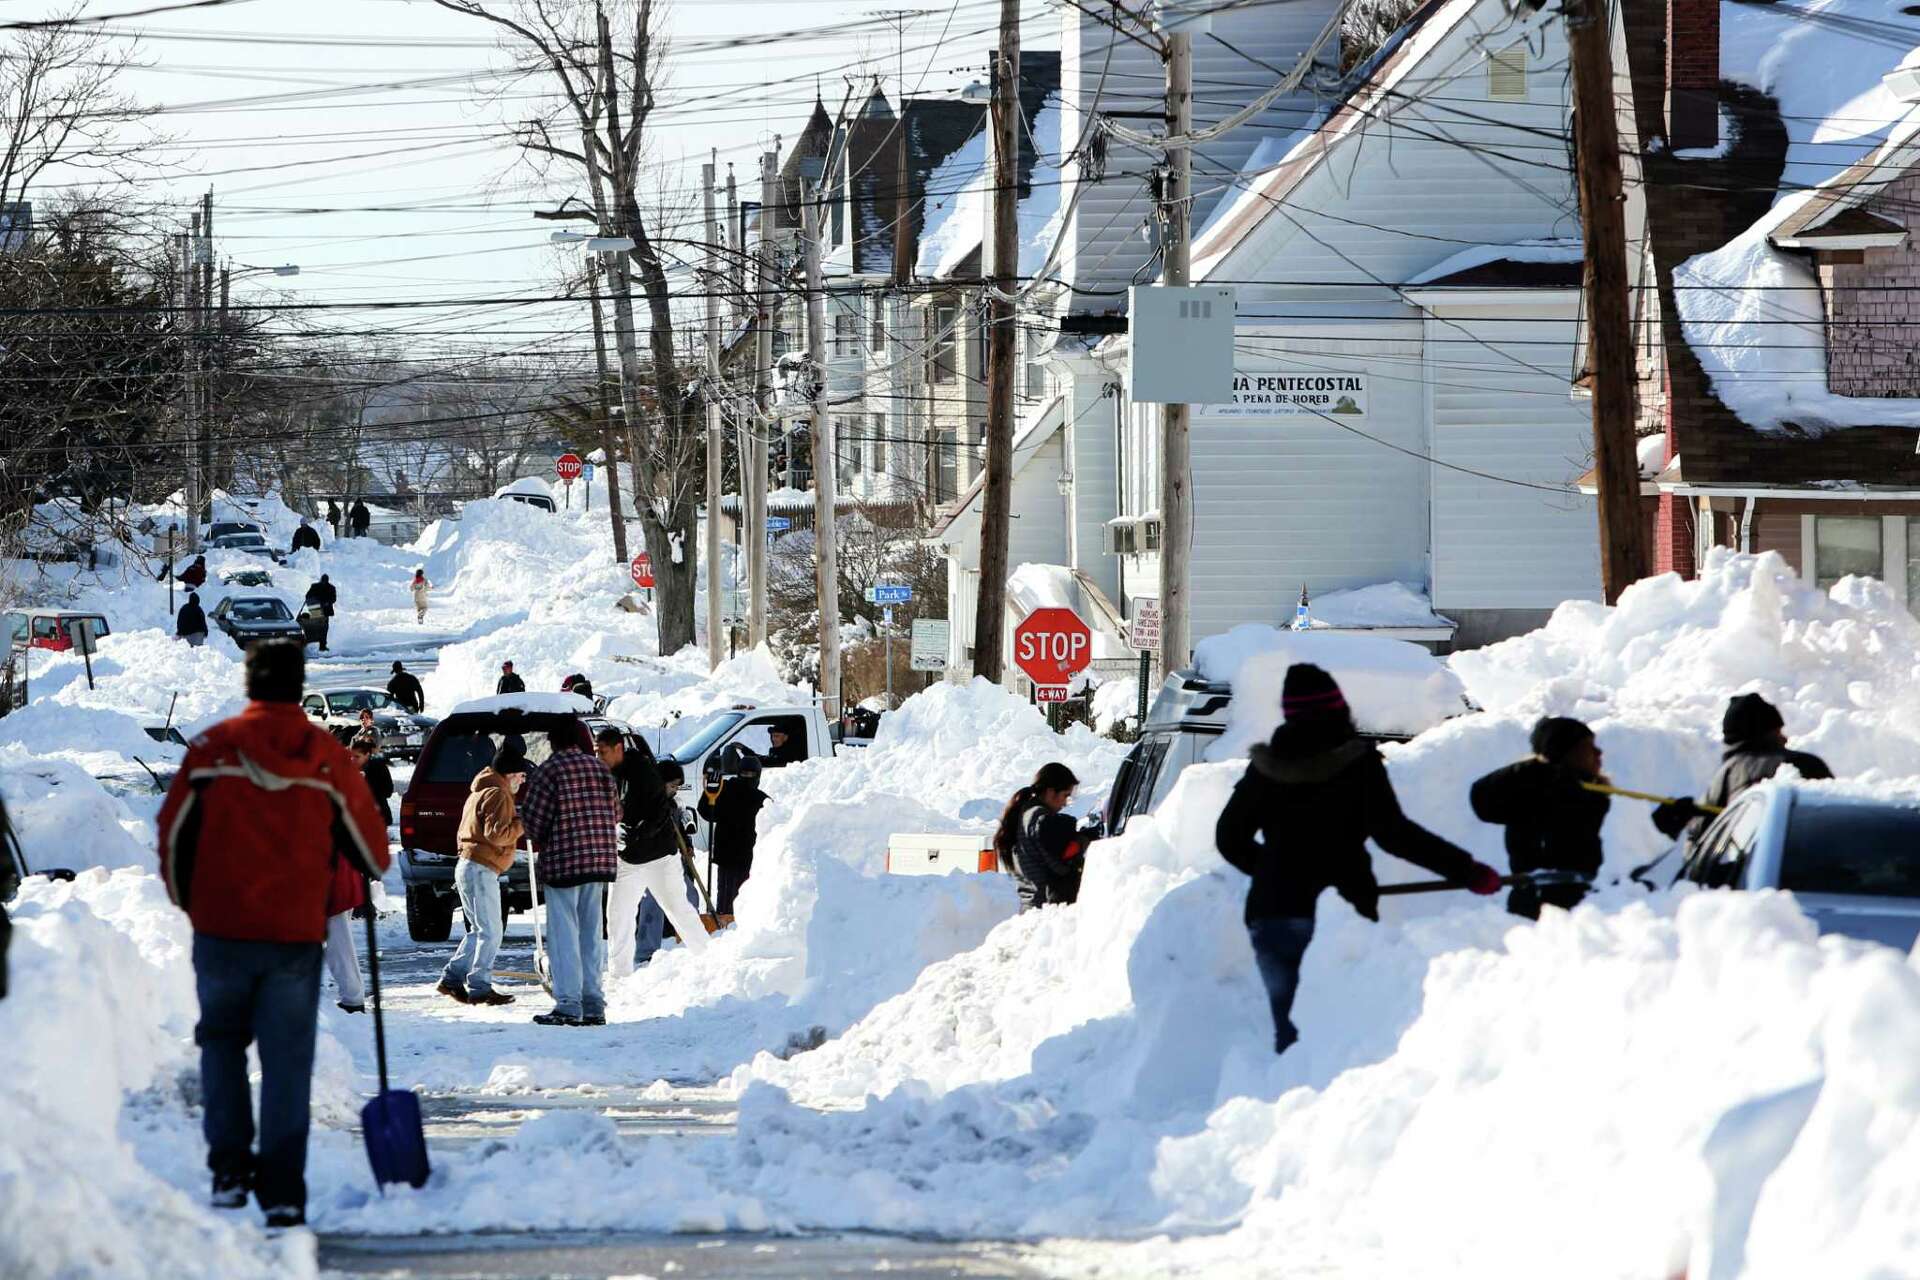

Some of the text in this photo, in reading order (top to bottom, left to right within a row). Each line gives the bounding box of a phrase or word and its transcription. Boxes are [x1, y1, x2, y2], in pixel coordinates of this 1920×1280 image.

[1257, 377, 1363, 390] PENTECOSTAL
[1275, 394, 1289, 404] DE
[1292, 394, 1330, 405] HOREB
[557, 462, 580, 473] STOP
[633, 563, 653, 577] STO
[878, 589, 900, 599] Park
[1019, 632, 1087, 661] STOP
[1038, 689, 1066, 699] 4-WAY
